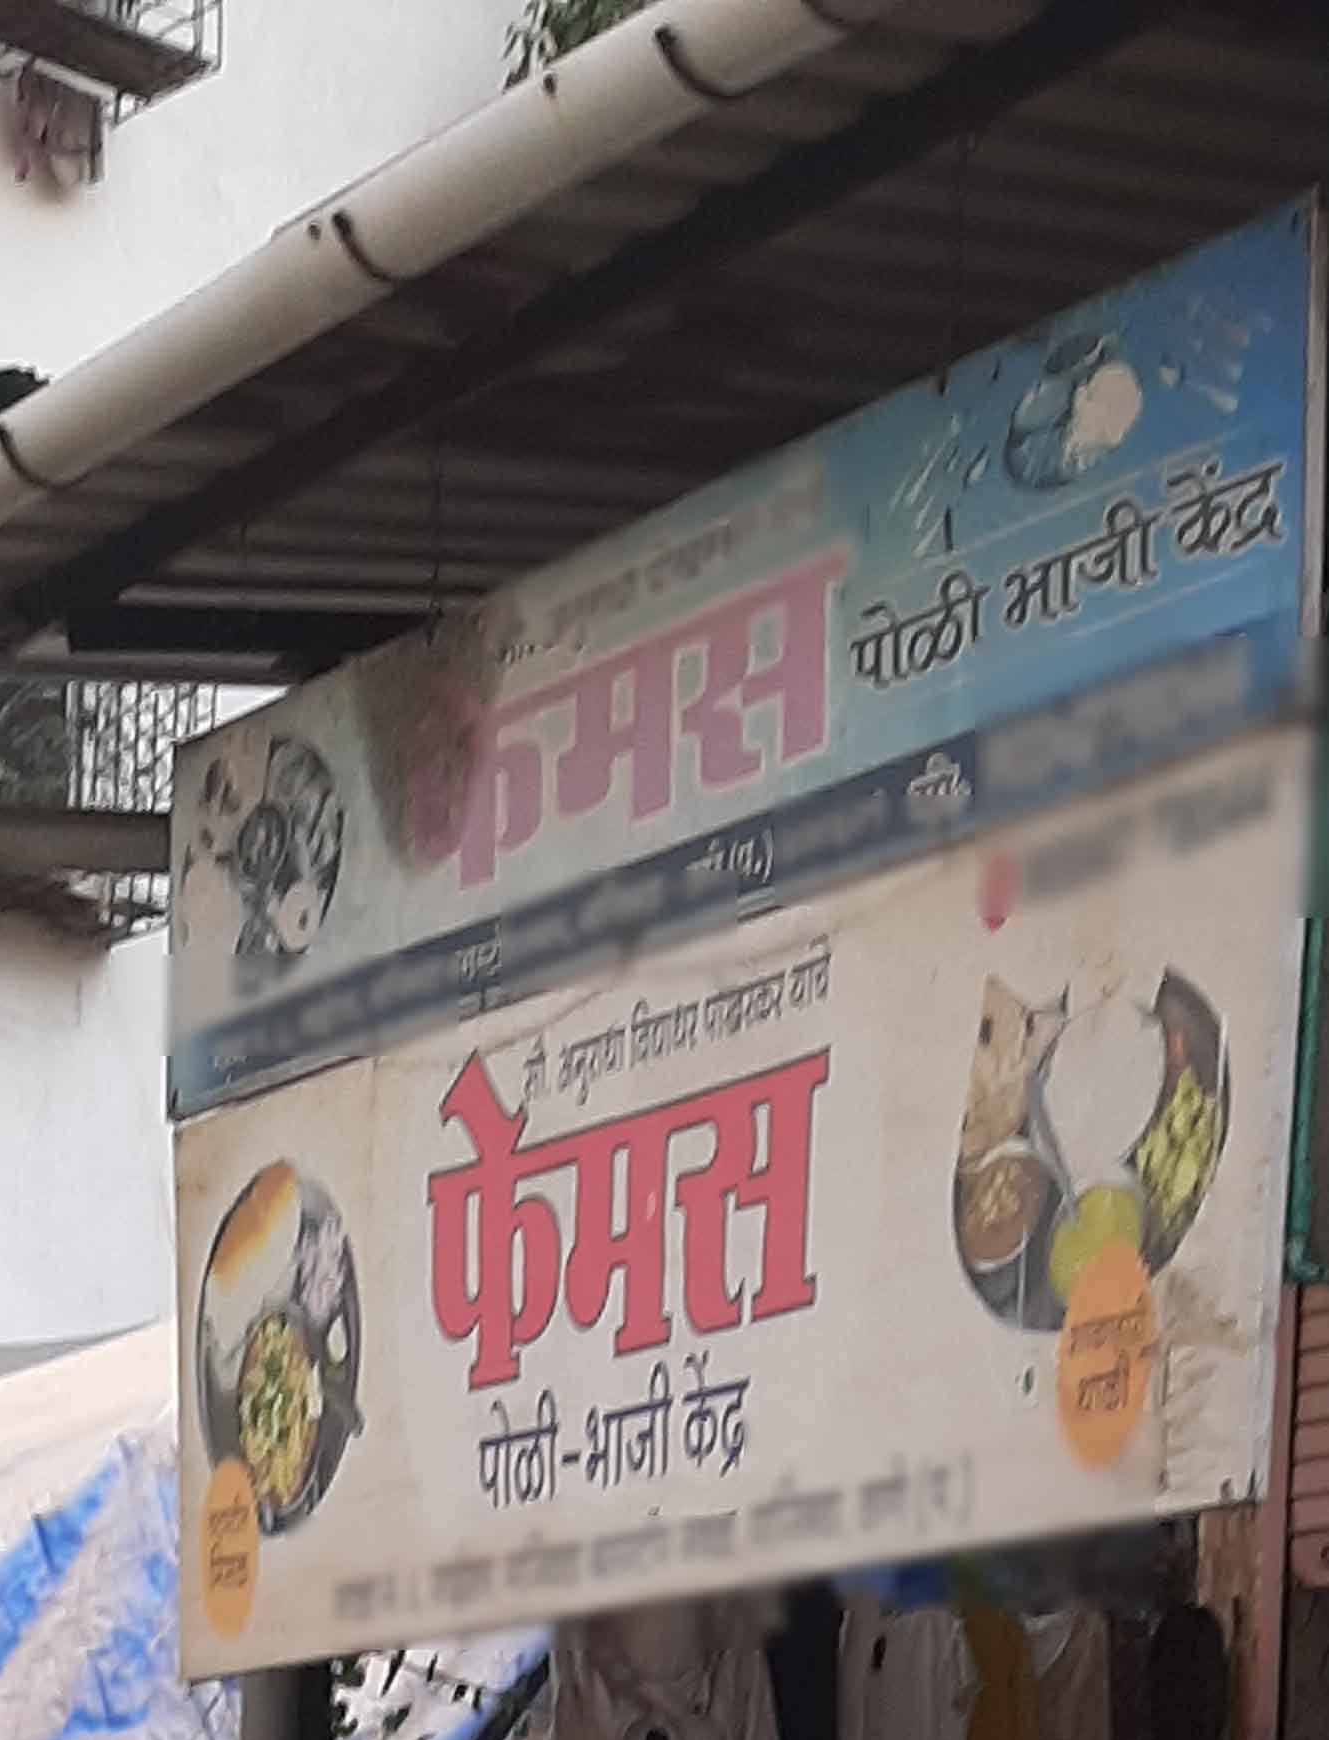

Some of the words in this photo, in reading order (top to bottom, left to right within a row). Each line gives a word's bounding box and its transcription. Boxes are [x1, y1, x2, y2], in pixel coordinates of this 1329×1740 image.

[849, 570, 991, 688] पोळी
[1003, 499, 1164, 627] भाजी
[1165, 457, 1286, 555] केंद्र
[426, 1048, 832, 1392] फेमस
[680, 1350, 751, 1479] केंद्र
